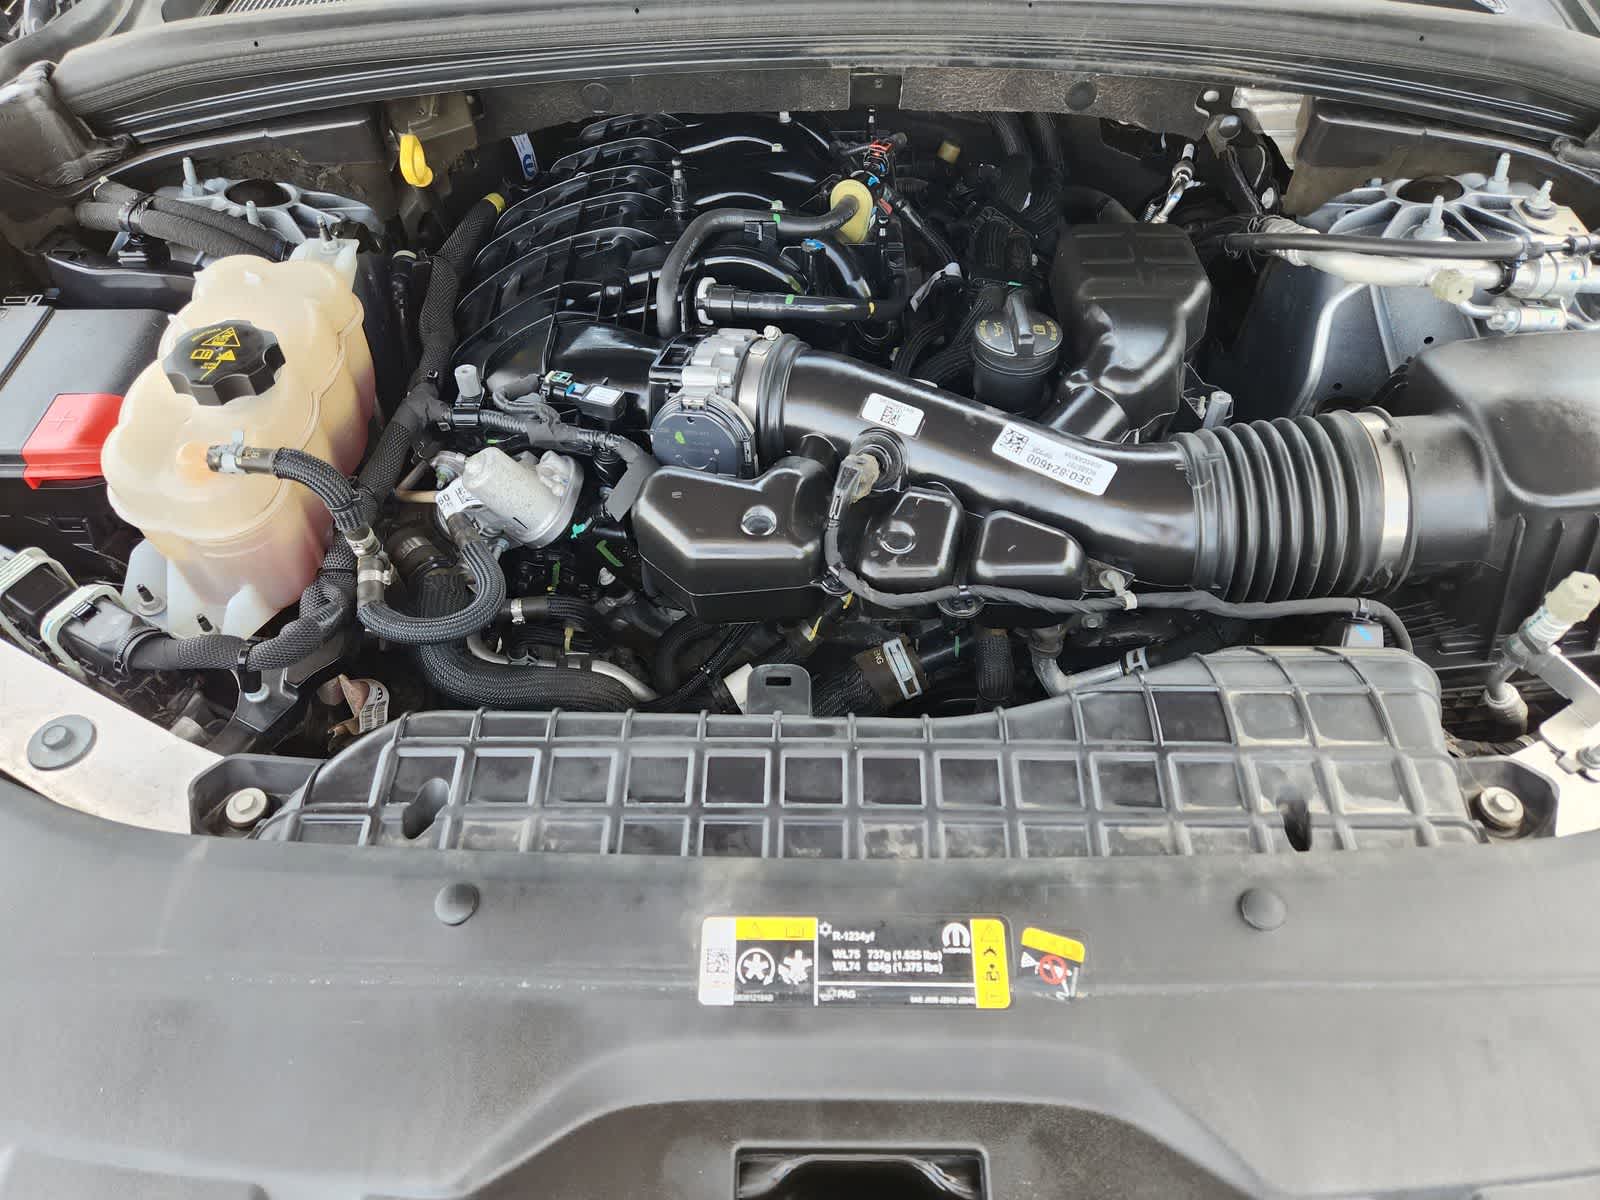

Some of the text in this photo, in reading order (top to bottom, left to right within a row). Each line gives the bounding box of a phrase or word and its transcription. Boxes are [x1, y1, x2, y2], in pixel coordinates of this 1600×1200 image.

[832, 930, 876, 943] R-1234yf
[832, 949, 861, 960] WL75
[867, 949, 891, 962] 737g
[923, 949, 943, 962] lbs)
[832, 961, 861, 972] WL74
[923, 962, 944, 975] lbs)
